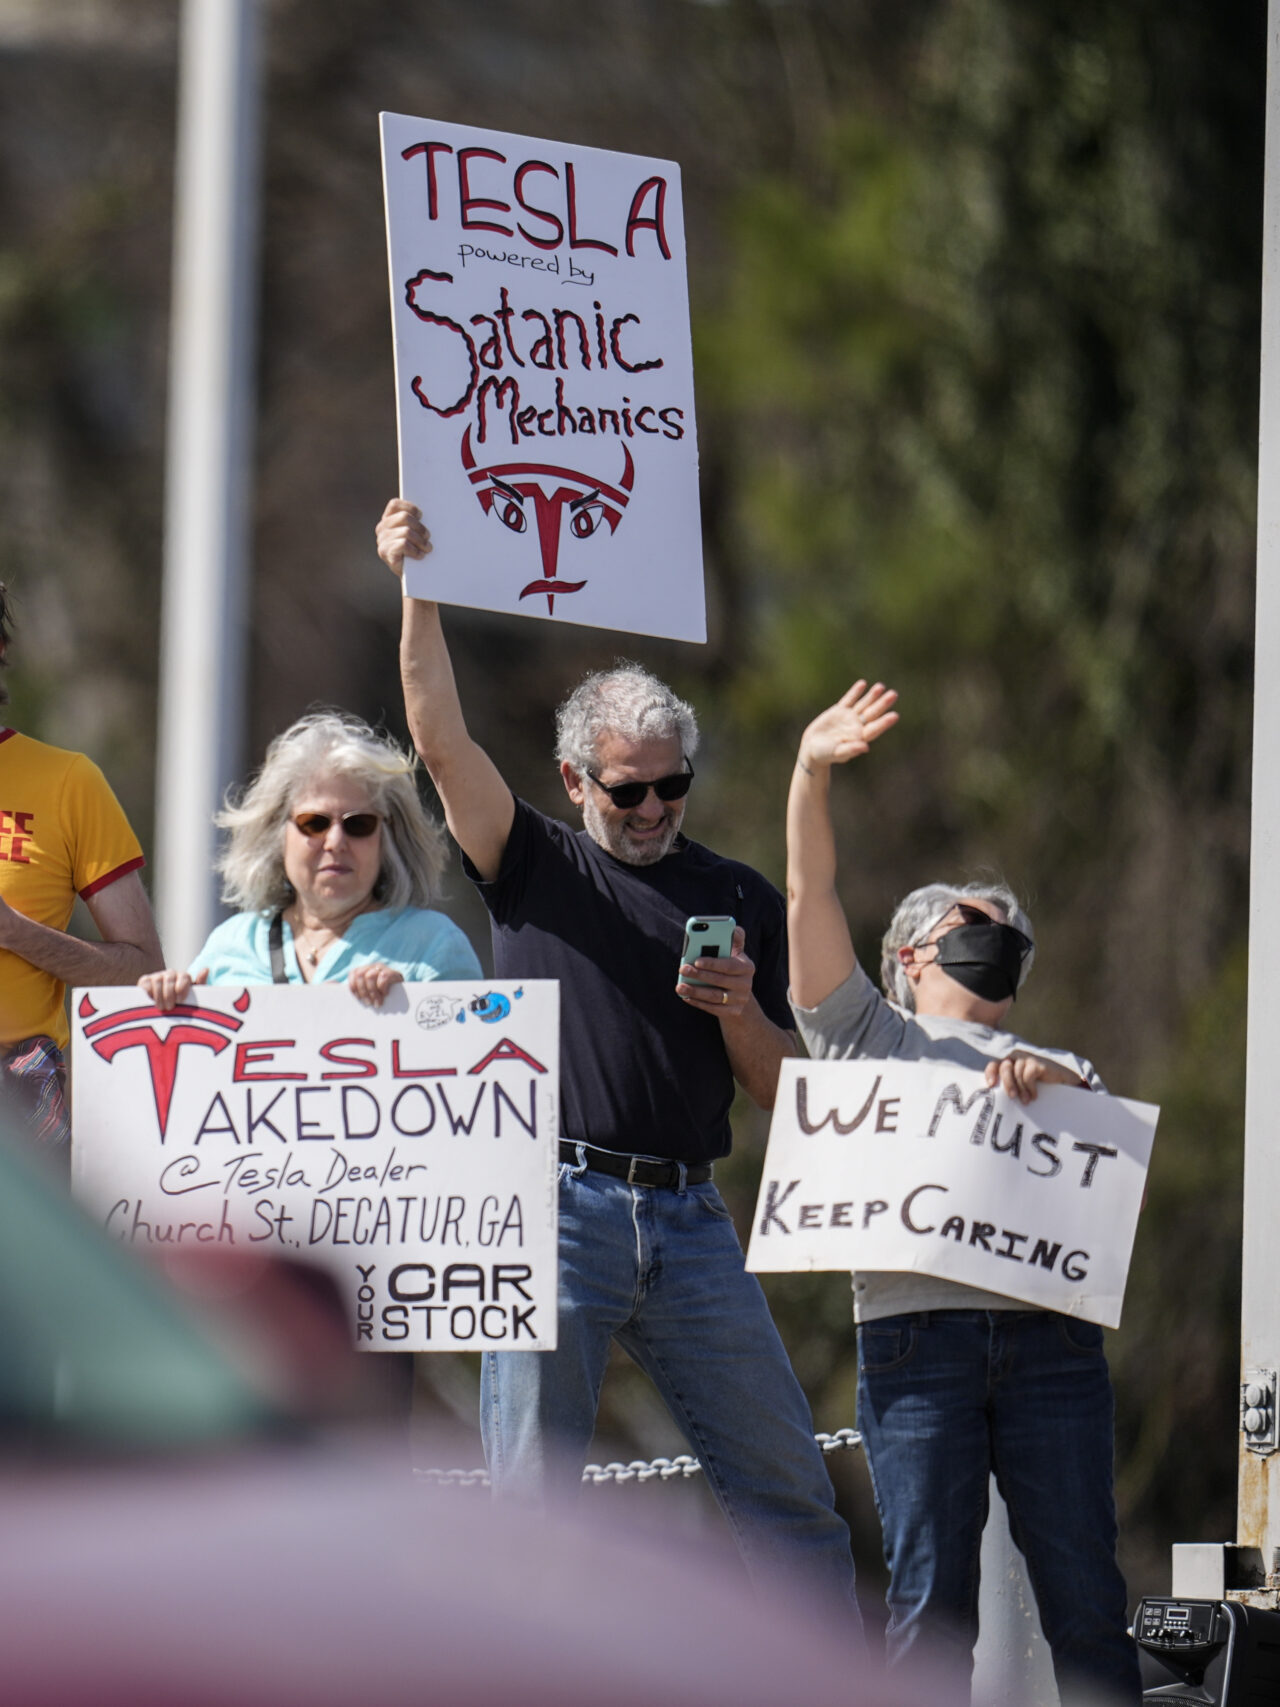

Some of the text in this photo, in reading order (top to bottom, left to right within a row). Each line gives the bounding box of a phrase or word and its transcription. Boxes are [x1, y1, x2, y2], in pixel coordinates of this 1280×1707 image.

[401, 141, 671, 260] TESLA
[458, 244, 596, 286] powered by
[405, 269, 664, 418] Satanic
[475, 375, 685, 445] Mechanics
[796, 1075, 1118, 1188] WE MUST
[160, 1146, 428, 1195] @ Tesla Dealer
[105, 1198, 236, 1246] Church
[307, 1196, 470, 1248] DECATUR,
[477, 1195, 525, 1247] GA
[759, 1180, 1091, 1283] KEEP CARING
[356, 1264, 376, 1342] YOUR
[388, 1263, 534, 1303] CAR
[382, 1305, 538, 1342] STOCK
